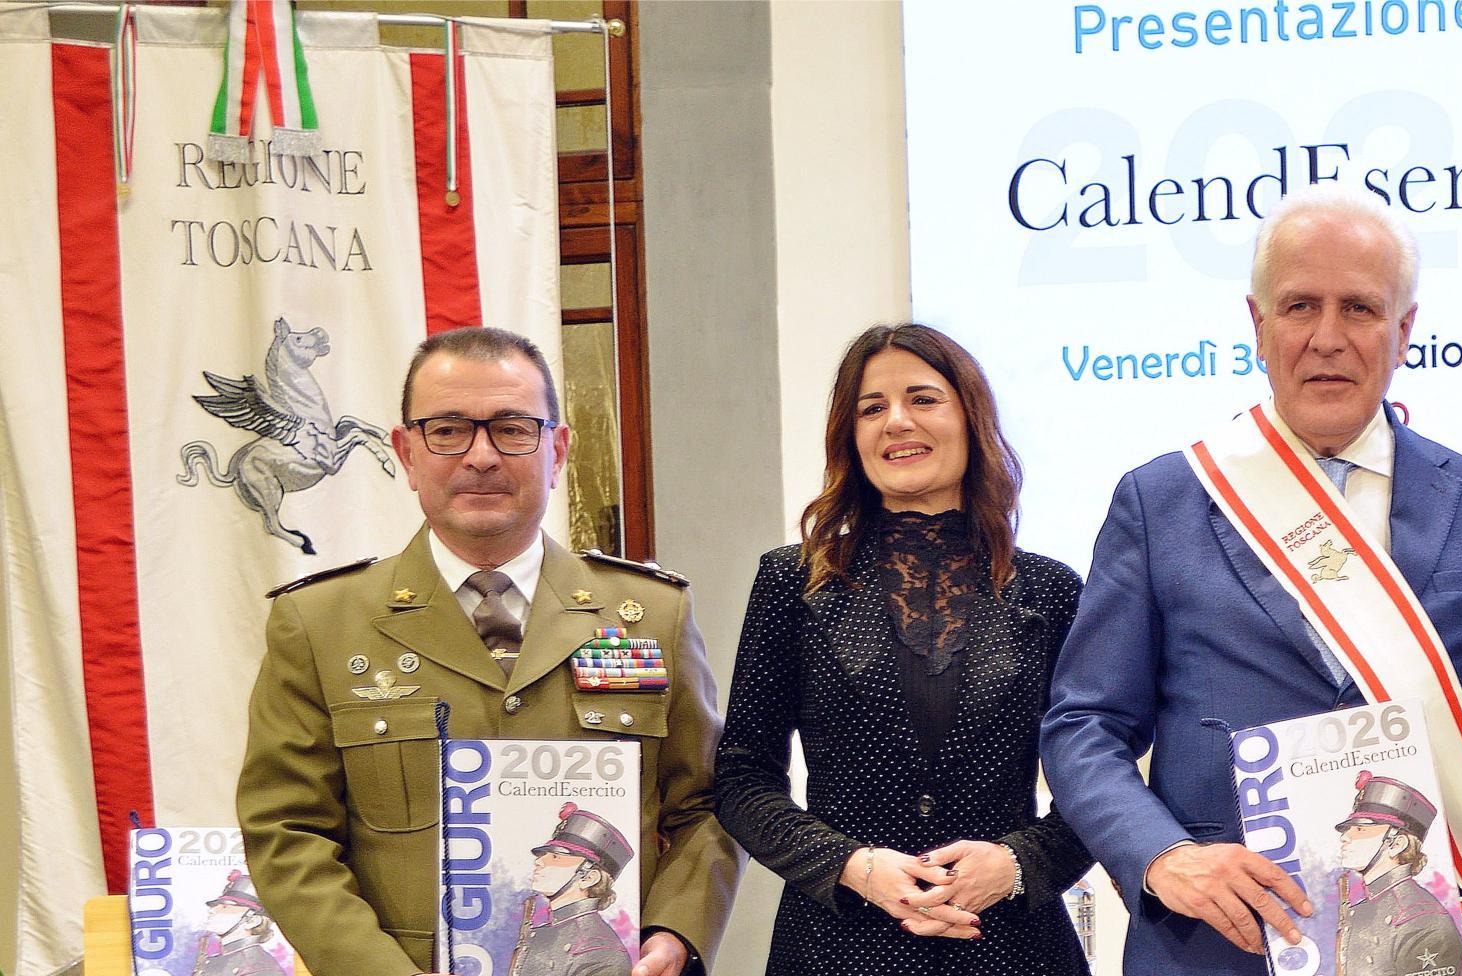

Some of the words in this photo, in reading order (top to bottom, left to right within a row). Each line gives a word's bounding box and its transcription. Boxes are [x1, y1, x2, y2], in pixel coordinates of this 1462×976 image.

[174, 139, 367, 195] REGIONE
[171, 216, 373, 272] TOSCANA
[1062, 340, 1217, 381] Venerdì
[1281, 512, 1324, 544] REGIONE
[1286, 521, 1331, 551] TOSCANA
[1284, 705, 1411, 760] 2026
[499, 744, 625, 781] 2026
[1290, 743, 1417, 778] CalendEsercito
[498, 781, 626, 798] CalendEsercito
[178, 830, 245, 854] 202
[441, 740, 494, 931] GIURO
[134, 828, 174, 960] GIURO
